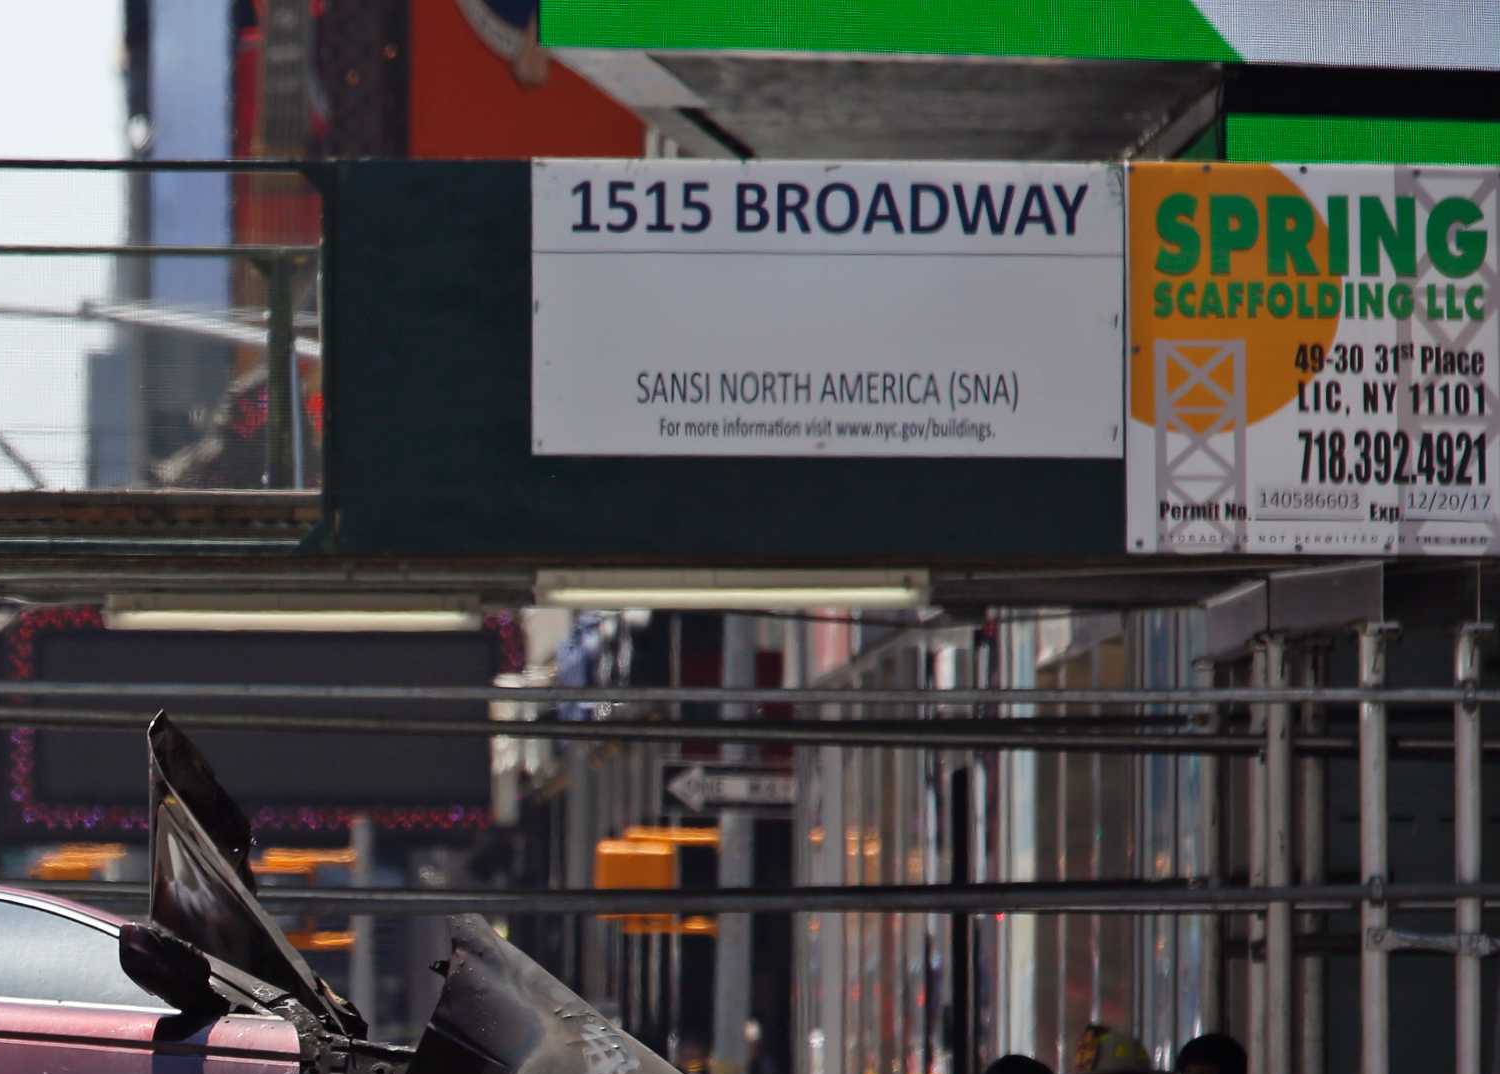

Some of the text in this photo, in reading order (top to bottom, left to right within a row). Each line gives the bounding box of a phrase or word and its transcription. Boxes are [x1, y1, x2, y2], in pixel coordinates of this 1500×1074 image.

[571, 181, 1088, 236] 1515 BROADWAY
[1153, 193, 1489, 279] SPRING
[1153, 281, 1485, 321] SCAFFOLDING LLC
[1295, 342, 1485, 377] 49-30 31st Place
[637, 371, 1019, 412] SANSI NORTH AMERICA (SNA)
[1298, 381, 1486, 416] LIC, NY 11101
[660, 418, 680, 437] For
[684, 421, 719, 437] more
[723, 418, 800, 437] information
[805, 418, 831, 437] visit
[1298, 430, 1487, 486] 718.392.4921
[1159, 502, 1220, 522] Permit
[1224, 503, 1251, 522] No.
[1407, 491, 1492, 512] 12/20/17
